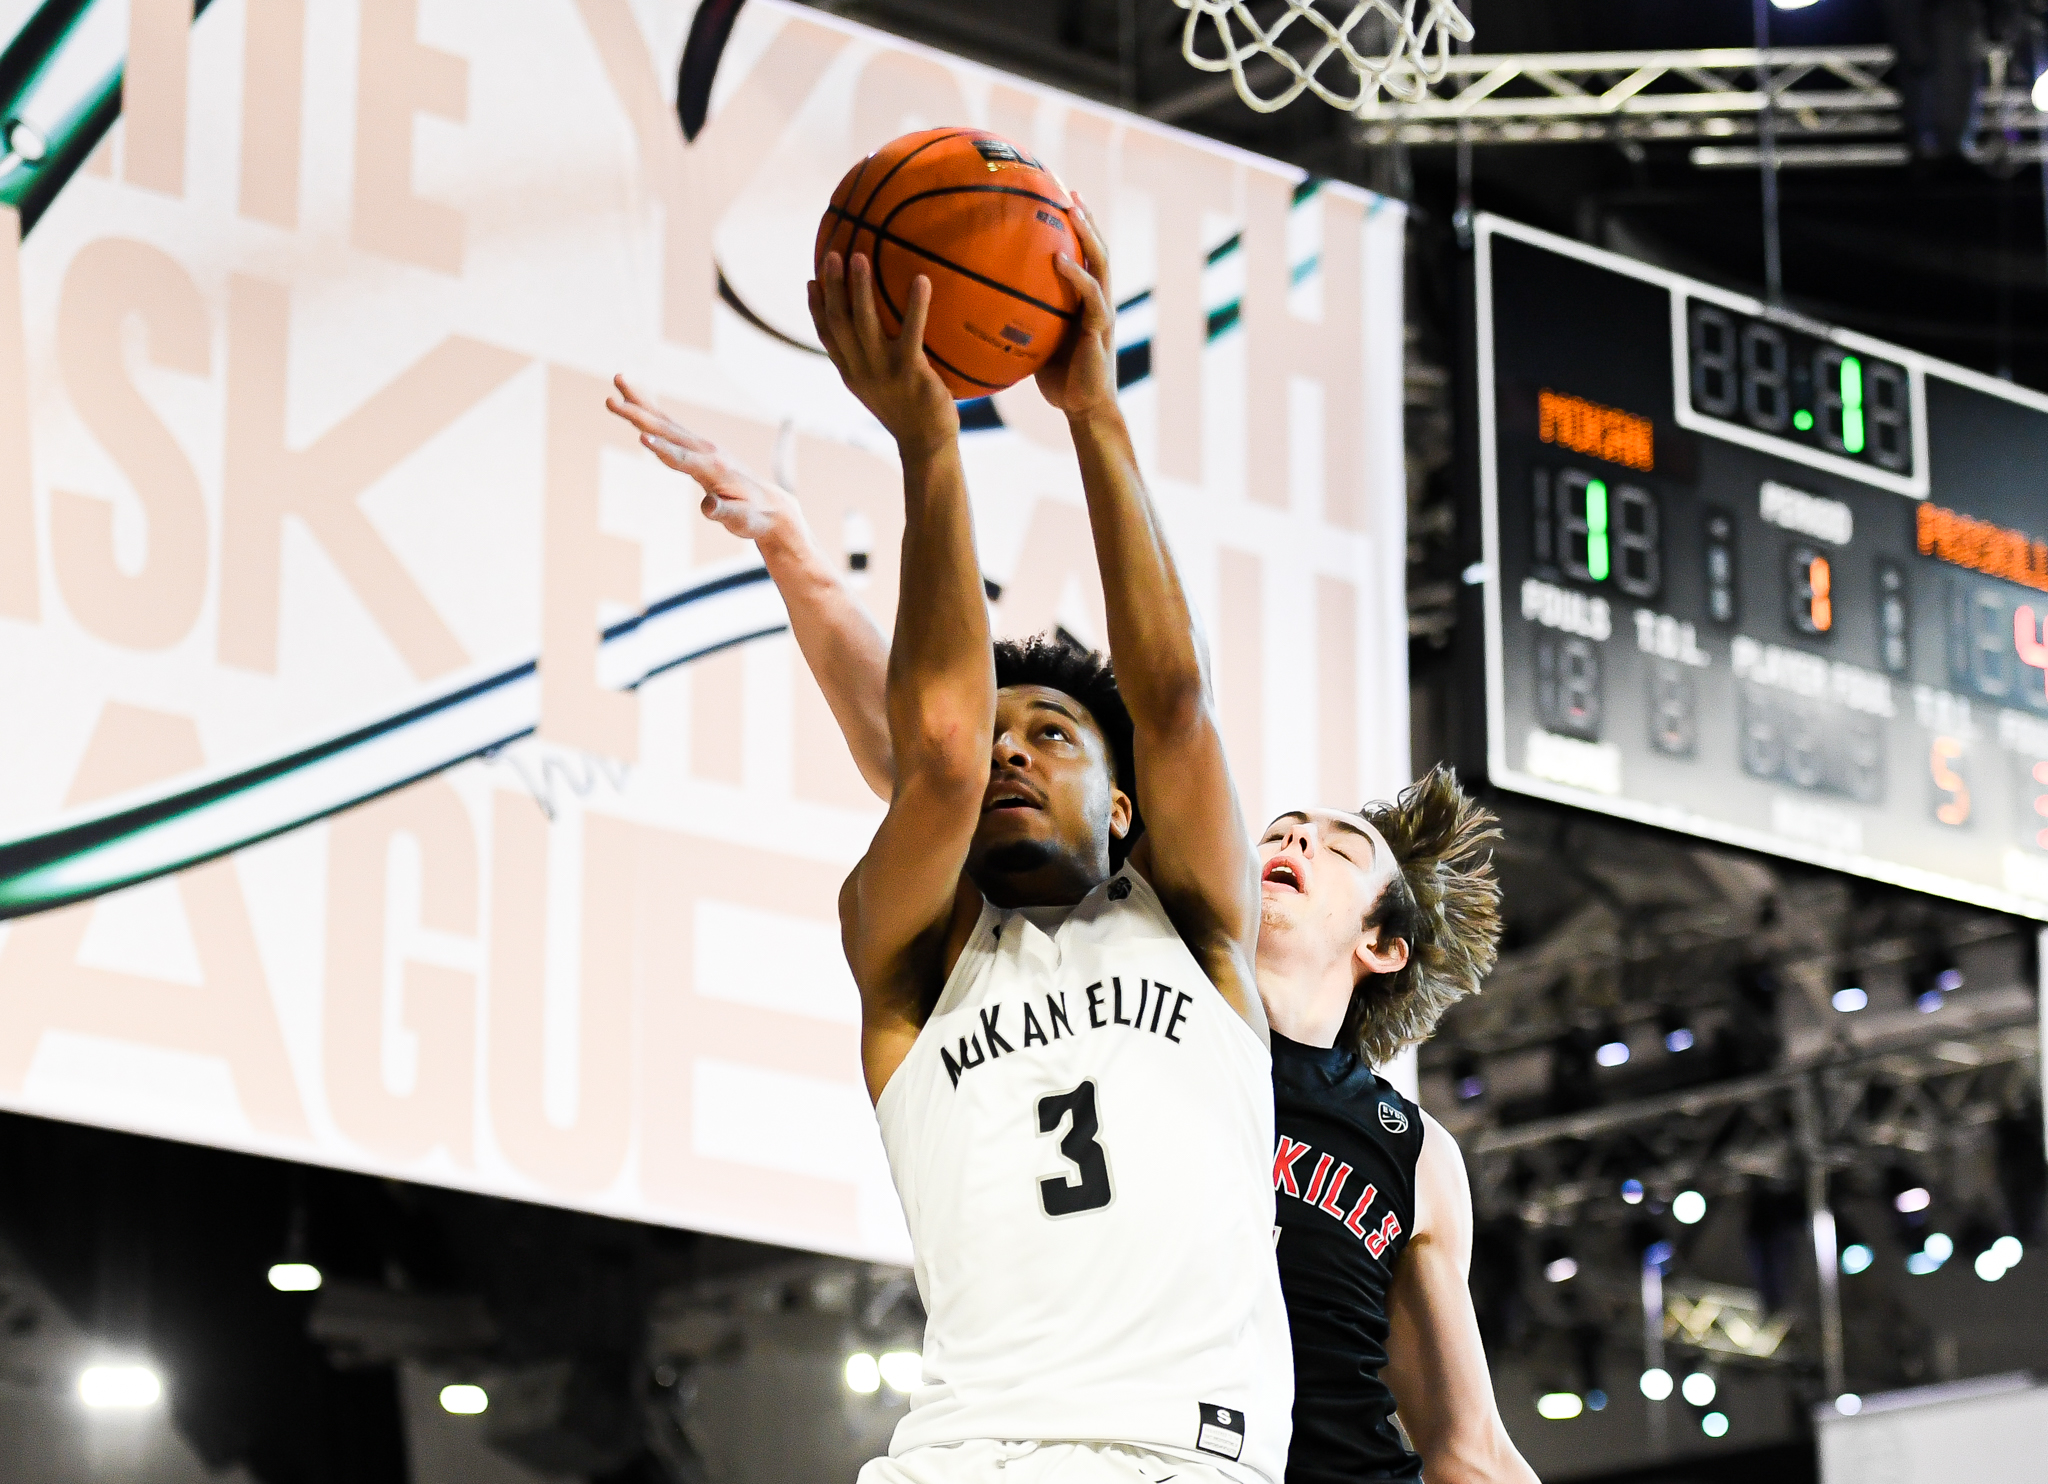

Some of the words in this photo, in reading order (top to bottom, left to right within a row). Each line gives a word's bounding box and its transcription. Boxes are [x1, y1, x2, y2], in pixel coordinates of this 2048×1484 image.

[576, 0, 1367, 533] YTH
[1085, 975, 1194, 1045] ELITE
[1034, 1076, 1117, 1221] 3
[1273, 1135, 1402, 1260] KILLS
